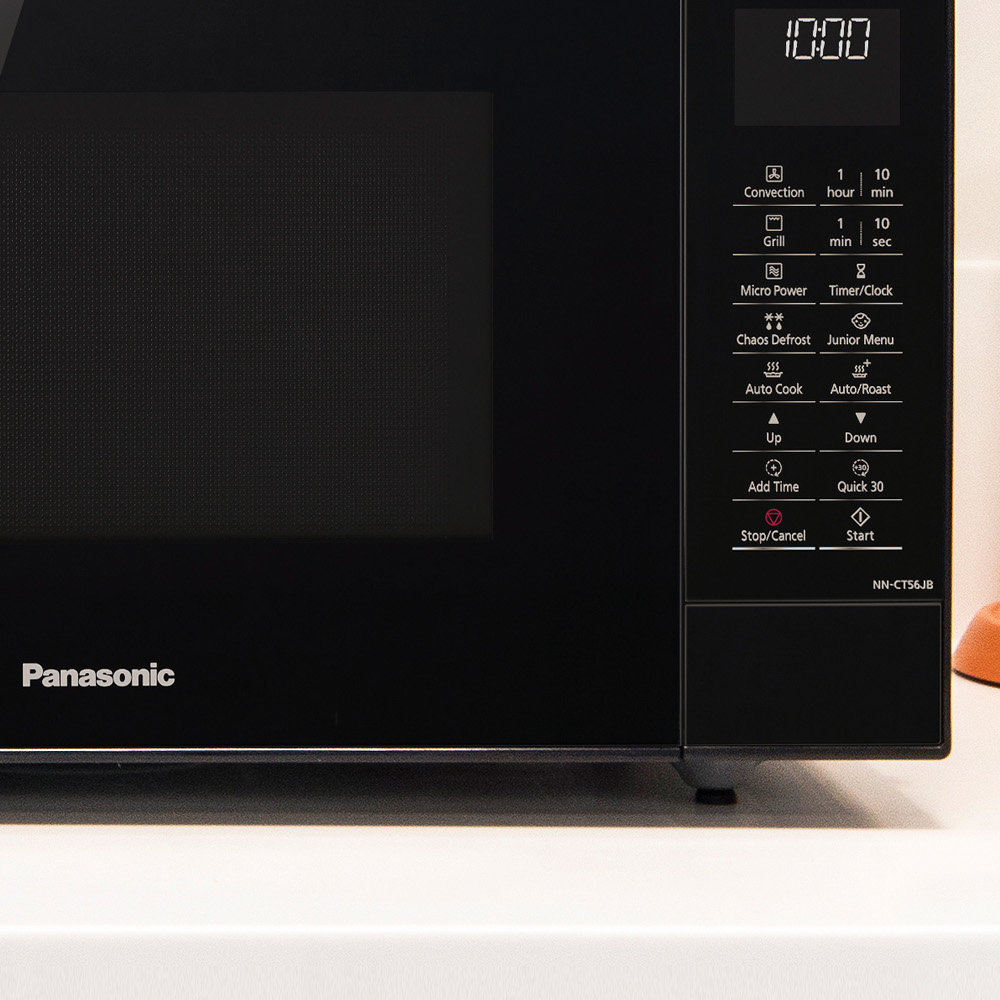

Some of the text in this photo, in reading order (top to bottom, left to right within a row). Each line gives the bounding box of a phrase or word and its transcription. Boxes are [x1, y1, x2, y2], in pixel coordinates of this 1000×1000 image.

[785, 17, 871, 61] 10:00
[837, 168, 844, 181] 1
[874, 168, 891, 181] 10
[744, 185, 805, 198] Convection
[827, 185, 856, 198] hour
[870, 185, 894, 198] min
[837, 217, 844, 230] 1
[874, 217, 891, 230] 10
[763, 234, 785, 247] Grill
[829, 235, 852, 247] min
[872, 238, 892, 248] sec
[740, 284, 808, 297] Micro Power
[828, 284, 894, 297] Timer/Clock
[736, 333, 812, 346] Chaos Defrost
[826, 333, 895, 346] Junior Menu
[745, 383, 804, 395] Auto Cook
[829, 383, 892, 395] Auto/Roast
[766, 431, 782, 446] Up
[844, 431, 877, 444] Down
[747, 480, 800, 493] Add Time
[837, 480, 884, 494] Quick 30
[741, 529, 806, 545] Stop/Cancel
[846, 529, 875, 542] Start
[872, 579, 934, 590] NN-CT56JB
[22, 662, 176, 688] Panasonic
